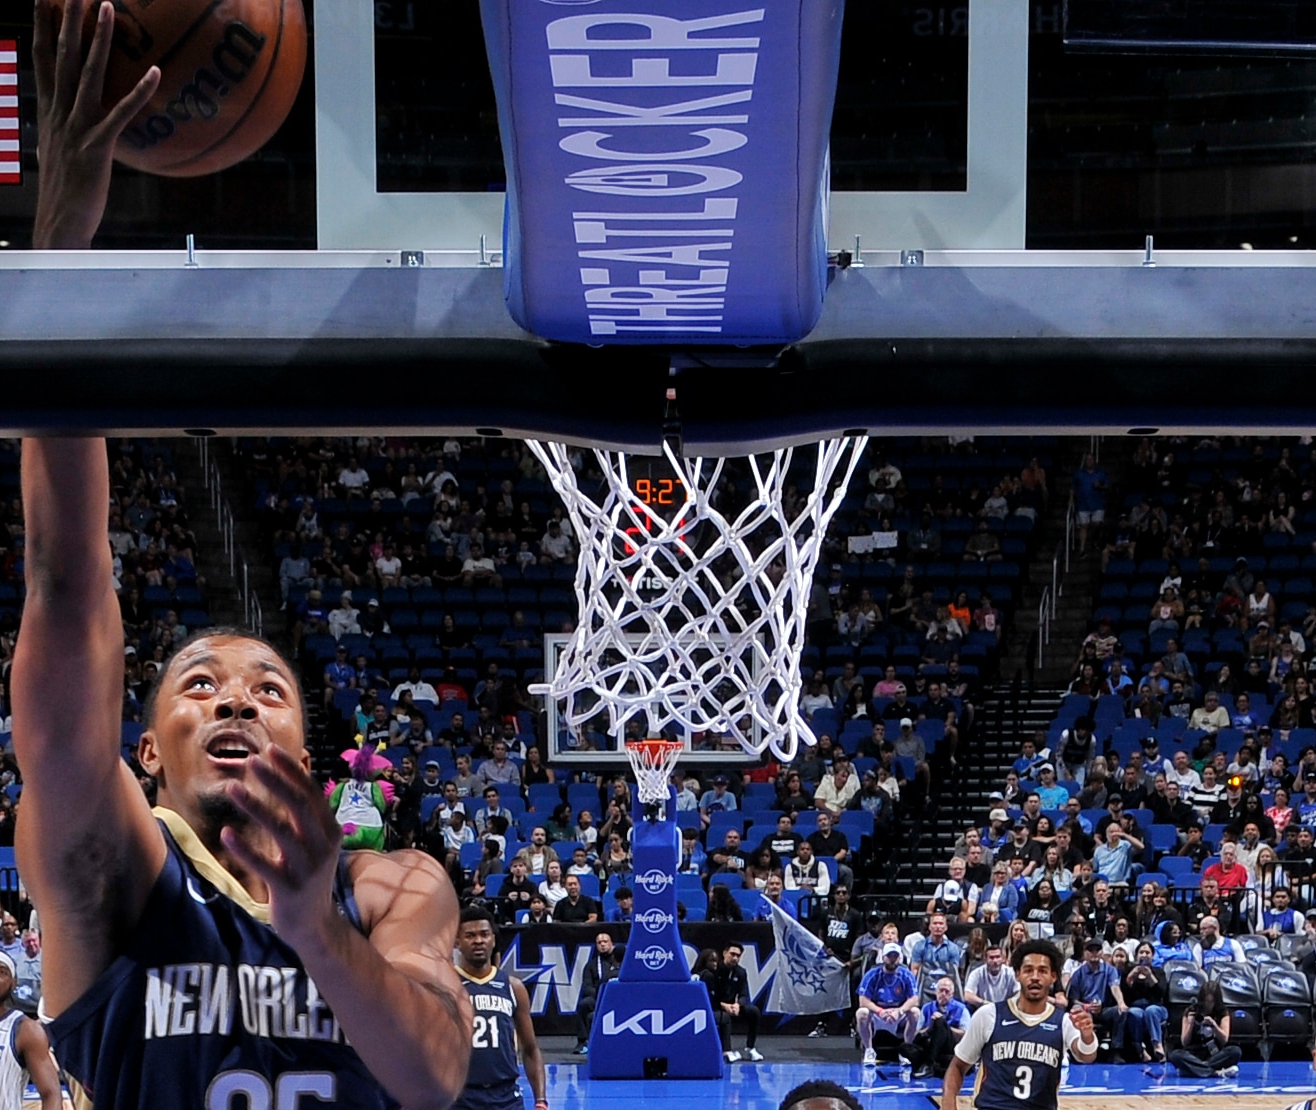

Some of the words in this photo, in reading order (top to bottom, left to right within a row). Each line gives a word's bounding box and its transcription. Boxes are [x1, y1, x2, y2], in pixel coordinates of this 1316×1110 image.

[546, 8, 765, 334] THREATLOCKER
[634, 874, 654, 883] Hard
[655, 874, 674, 885] Rock
[634, 913, 654, 922] Hard
[655, 913, 674, 924] Rock
[634, 950, 654, 959] Hard
[655, 950, 674, 961] Rock
[145, 964, 230, 1039] NEW
[237, 966, 348, 1044] ORLE
[475, 994, 513, 1018] ORLEANS
[472, 1015, 499, 1049] 21
[992, 1041, 1016, 1061] NEW
[1017, 1041, 1060, 1068] ORLEANS
[1013, 1065, 1033, 1100] 3
